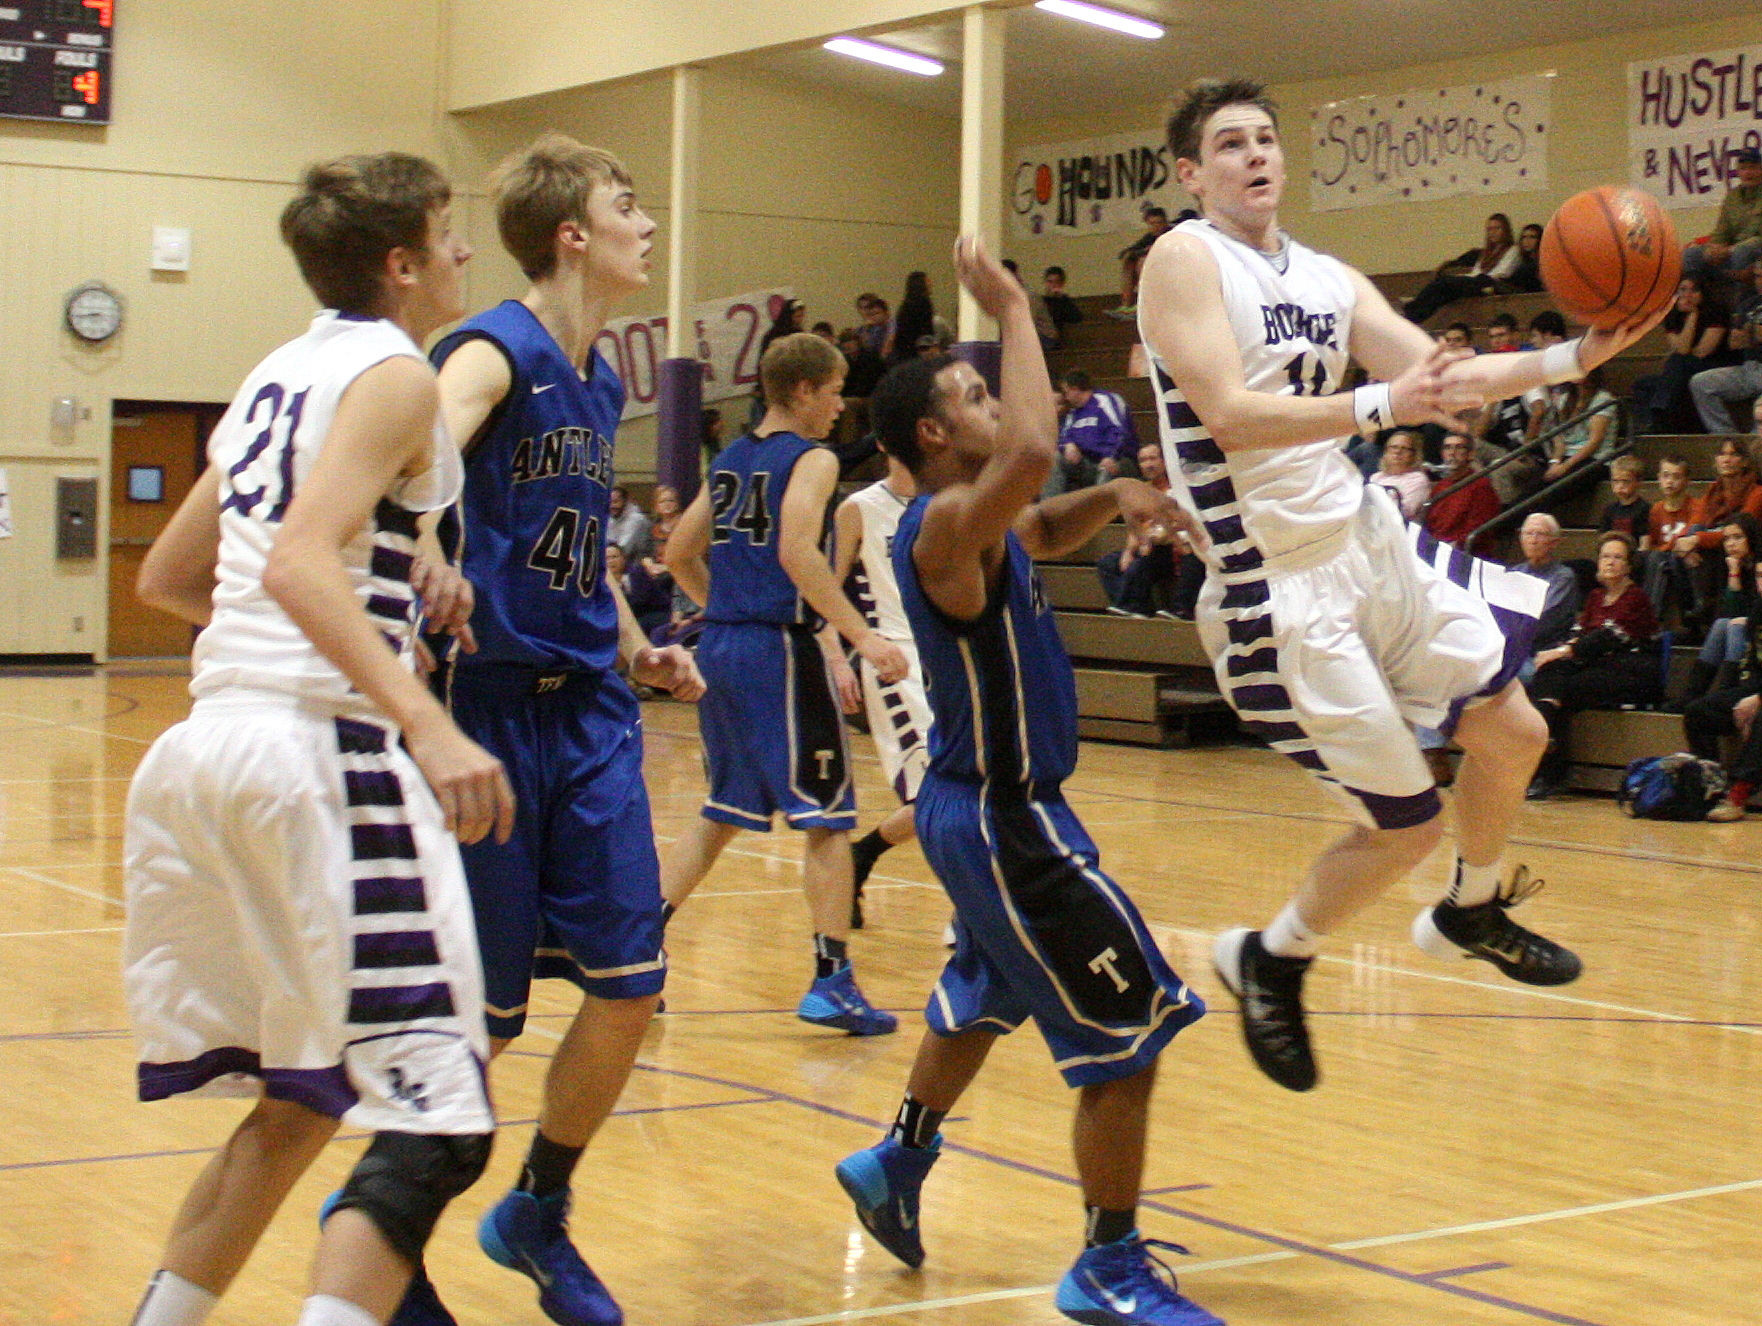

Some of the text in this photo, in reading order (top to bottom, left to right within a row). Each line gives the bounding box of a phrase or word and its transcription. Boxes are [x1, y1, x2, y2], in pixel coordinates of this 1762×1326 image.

[221, 382, 313, 522] 21
[711, 470, 773, 546] 24
[527, 506, 599, 598] 40
[814, 749, 835, 780] T
[1087, 946, 1130, 994] T
